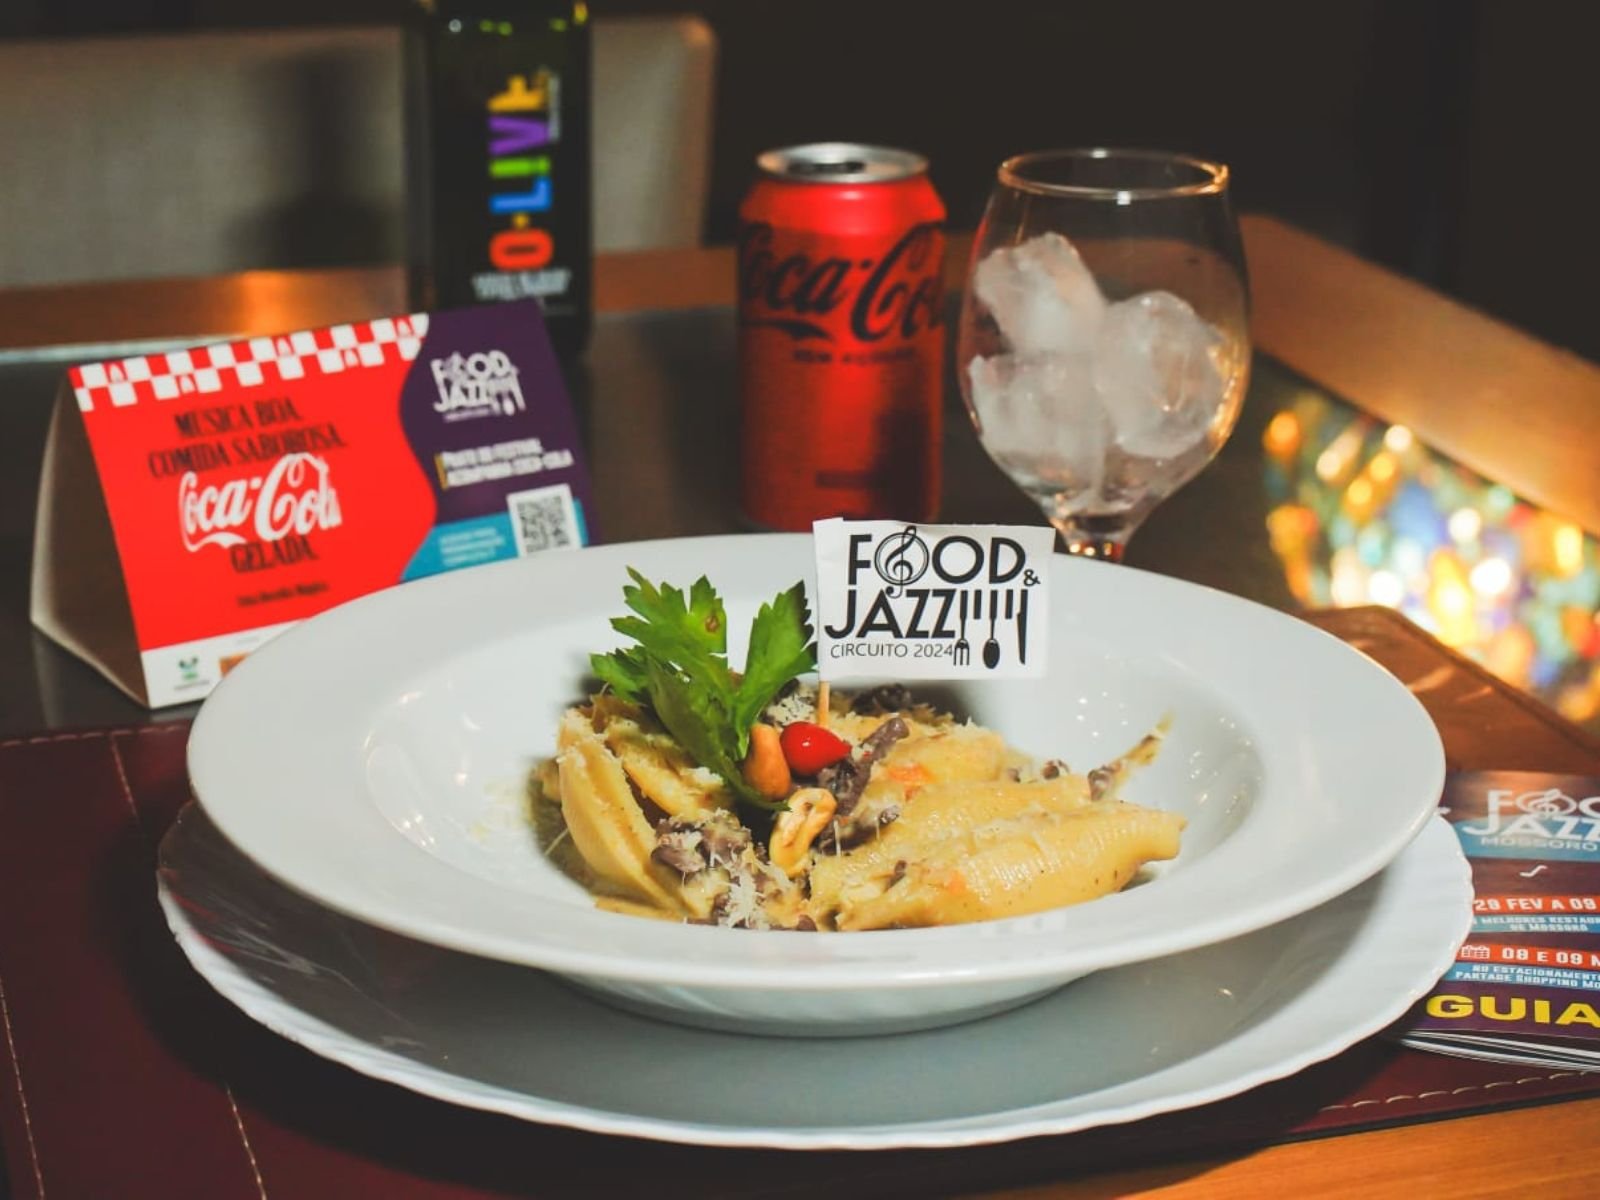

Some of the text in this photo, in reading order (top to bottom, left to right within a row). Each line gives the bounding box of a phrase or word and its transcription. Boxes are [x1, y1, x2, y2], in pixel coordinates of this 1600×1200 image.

[148, 421, 346, 478] COMIDA SABOROSA
[230, 536, 319, 574] GELADA
[848, 526, 1041, 587] FOOD &
[824, 588, 957, 639] JAZZ
[830, 642, 954, 659] CIRCUITO 2024
[1506, 898, 1543, 911] FEV
[1552, 898, 1565, 911] A
[1537, 951, 1549, 962] E
[1516, 974, 1579, 987] SHOPPING
[1426, 995, 1600, 1027] GUIA
